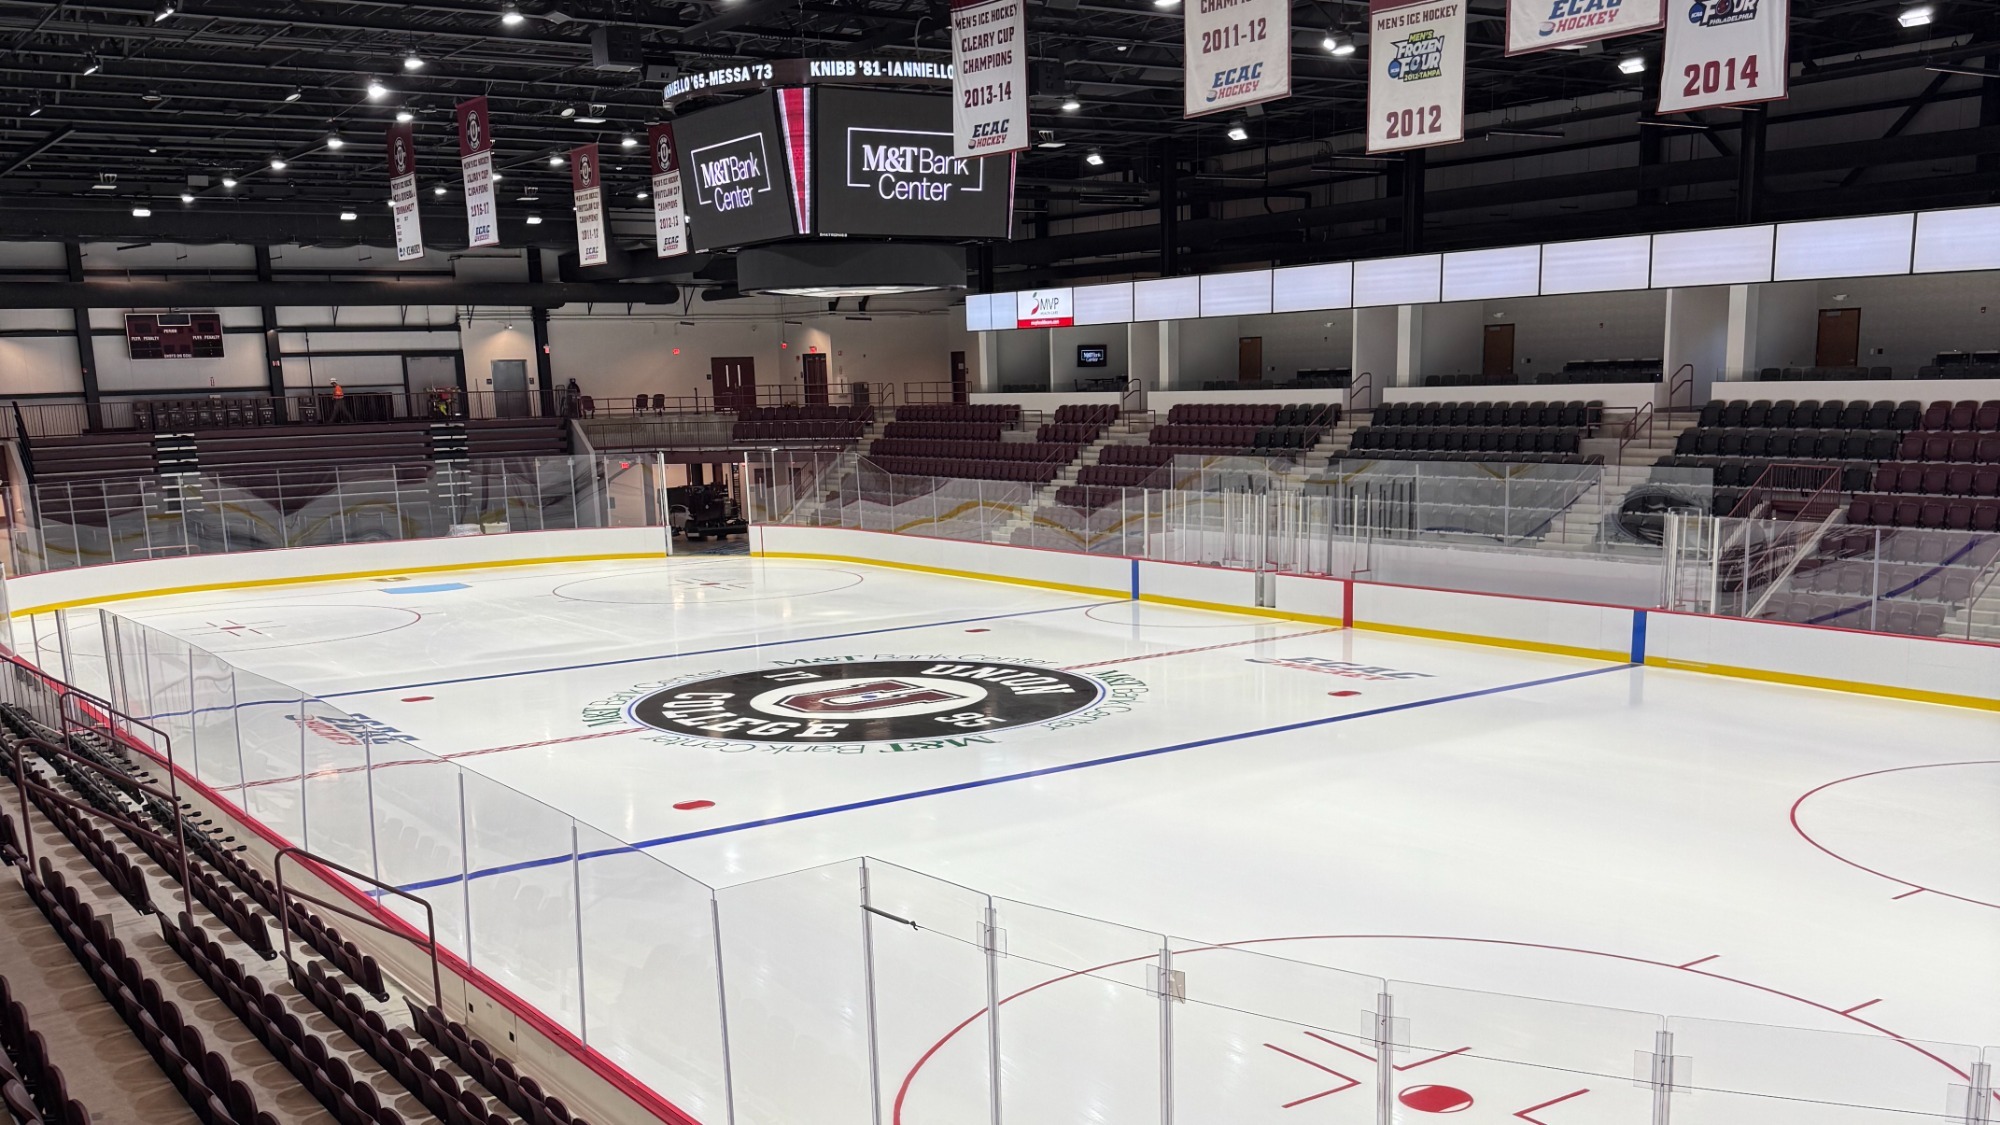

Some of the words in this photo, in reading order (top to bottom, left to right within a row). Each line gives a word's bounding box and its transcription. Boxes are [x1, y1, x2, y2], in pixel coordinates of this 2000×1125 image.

[955, 15, 977, 31] MEN'S
[978, 12, 989, 26] ICE
[991, 4, 1018, 19] HOCKEY
[1377, 15, 1405, 31] MEN'S
[1406, 12, 1420, 25] ICE
[1422, 5, 1458, 22] HOCKEY
[1556, 8, 1619, 33] HOCKEY
[1709, 12, 1753, 25] PHILADELPHIA
[961, 31, 995, 53] CLEARY
[997, 26, 1015, 44] CUP
[1202, 17, 1266, 54] 2011-12
[1394, 36, 1445, 58] FROZEN
[1409, 31, 1433, 43] MEN'S
[810, 61, 855, 76] KNIBB
[963, 50, 1012, 74] CHAMPIONS
[1212, 61, 1263, 88] ECAC
[1398, 52, 1441, 78] FOUR
[691, 66, 750, 90] '65-MESSA
[752, 64, 772, 79] '73
[1683, 54, 1758, 97] 2014
[964, 81, 1011, 108] 2013-14
[1218, 80, 1259, 99] HOCKEY
[972, 119, 1009, 138] ECAC
[1386, 104, 1441, 139] 2012
[976, 134, 1007, 148] HOCKEY
[714, 185, 753, 212] Center
[878, 173, 952, 201] Center
[1040, 297, 1059, 310] MVP
[771, 655, 863, 667] M&T
[921, 664, 1075, 695] UNION
[661, 692, 849, 738] COLLEGE
[638, 735, 756, 753] Center
[879, 736, 1002, 753] M&T
